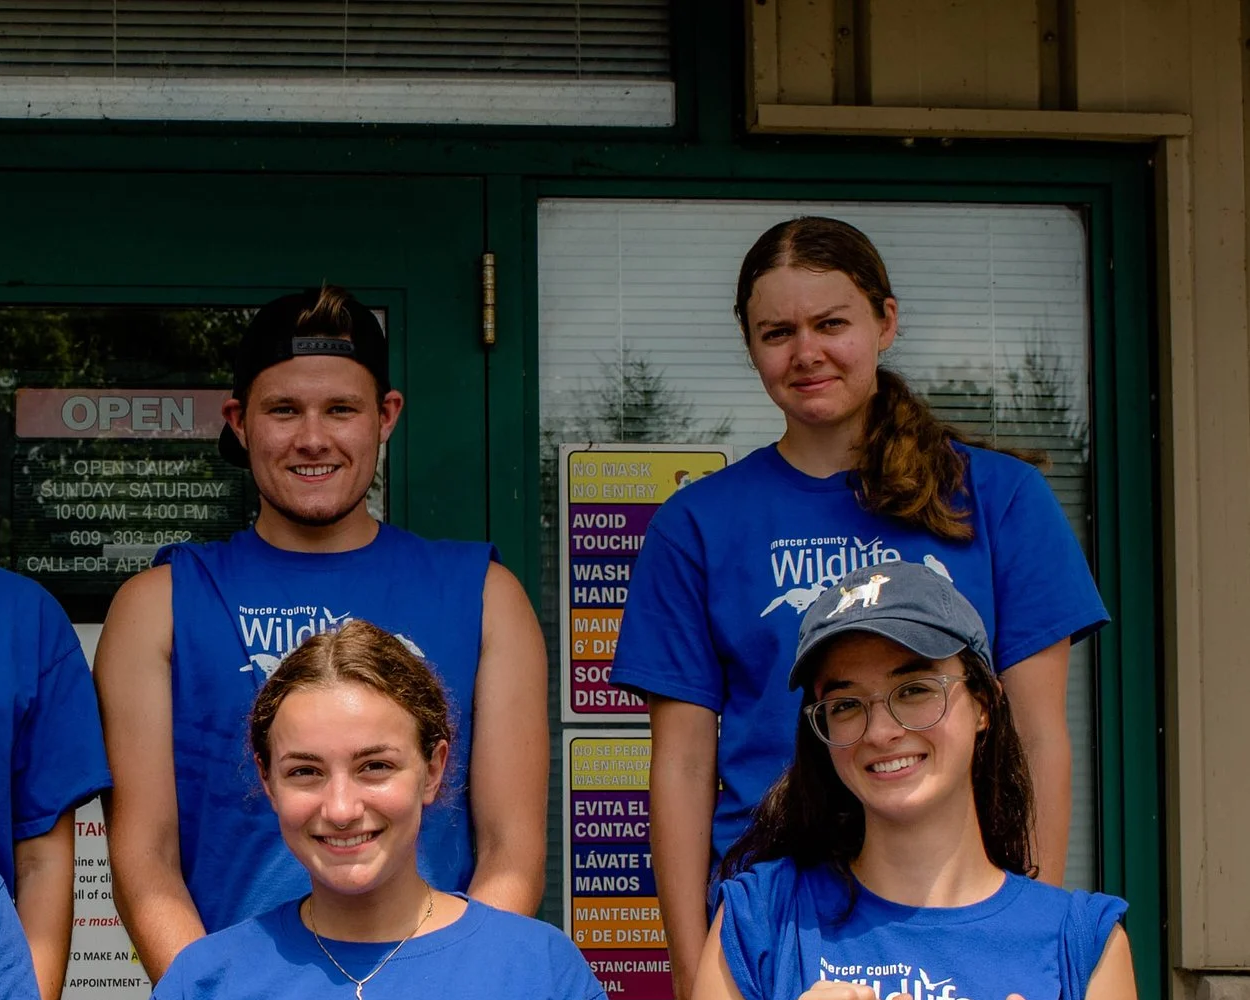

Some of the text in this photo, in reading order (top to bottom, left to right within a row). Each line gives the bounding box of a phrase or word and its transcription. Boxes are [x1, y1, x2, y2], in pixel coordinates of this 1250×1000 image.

[62, 396, 195, 432] OPEN
[74, 460, 184, 476] OPEN DAILY
[573, 463, 652, 477] NO MASK
[40, 483, 115, 498] SUNDAY
[129, 482, 223, 498] SATURDAY
[573, 484, 658, 498] NO ENTRY
[54, 504, 96, 519] 10:00
[100, 504, 126, 520] AM
[142, 504, 177, 519] 4:00
[184, 504, 209, 519] PM
[573, 513, 627, 529] AVOID
[771, 536, 848, 550] mercer county
[27, 557, 68, 572] CALL
[74, 557, 109, 572] FOR
[573, 564, 630, 581] WASH
[239, 605, 317, 616] mercer county
[574, 617, 623, 633] MAIN
[574, 746, 592, 756] NO
[596, 746, 611, 756] SE
[574, 760, 651, 771] LA ENTRADA
[574, 775, 649, 785] MASCARILL
[574, 801, 649, 816] EVITA EL
[574, 822, 650, 838] CONTAC
[575, 851, 640, 869] LÁVATE
[79, 875, 97, 883] our
[575, 876, 640, 892] MANOS
[87, 890, 99, 899] of
[576, 908, 660, 921] MANTENER
[592, 929, 612, 943] DE
[84, 951, 112, 961] MAKE
[114, 951, 129, 961] AN
[587, 961, 671, 973] STANCIAMIE
[820, 956, 912, 976] mercer county
[70, 978, 141, 987] APPOINTMENT
[599, 980, 625, 992] IAL
